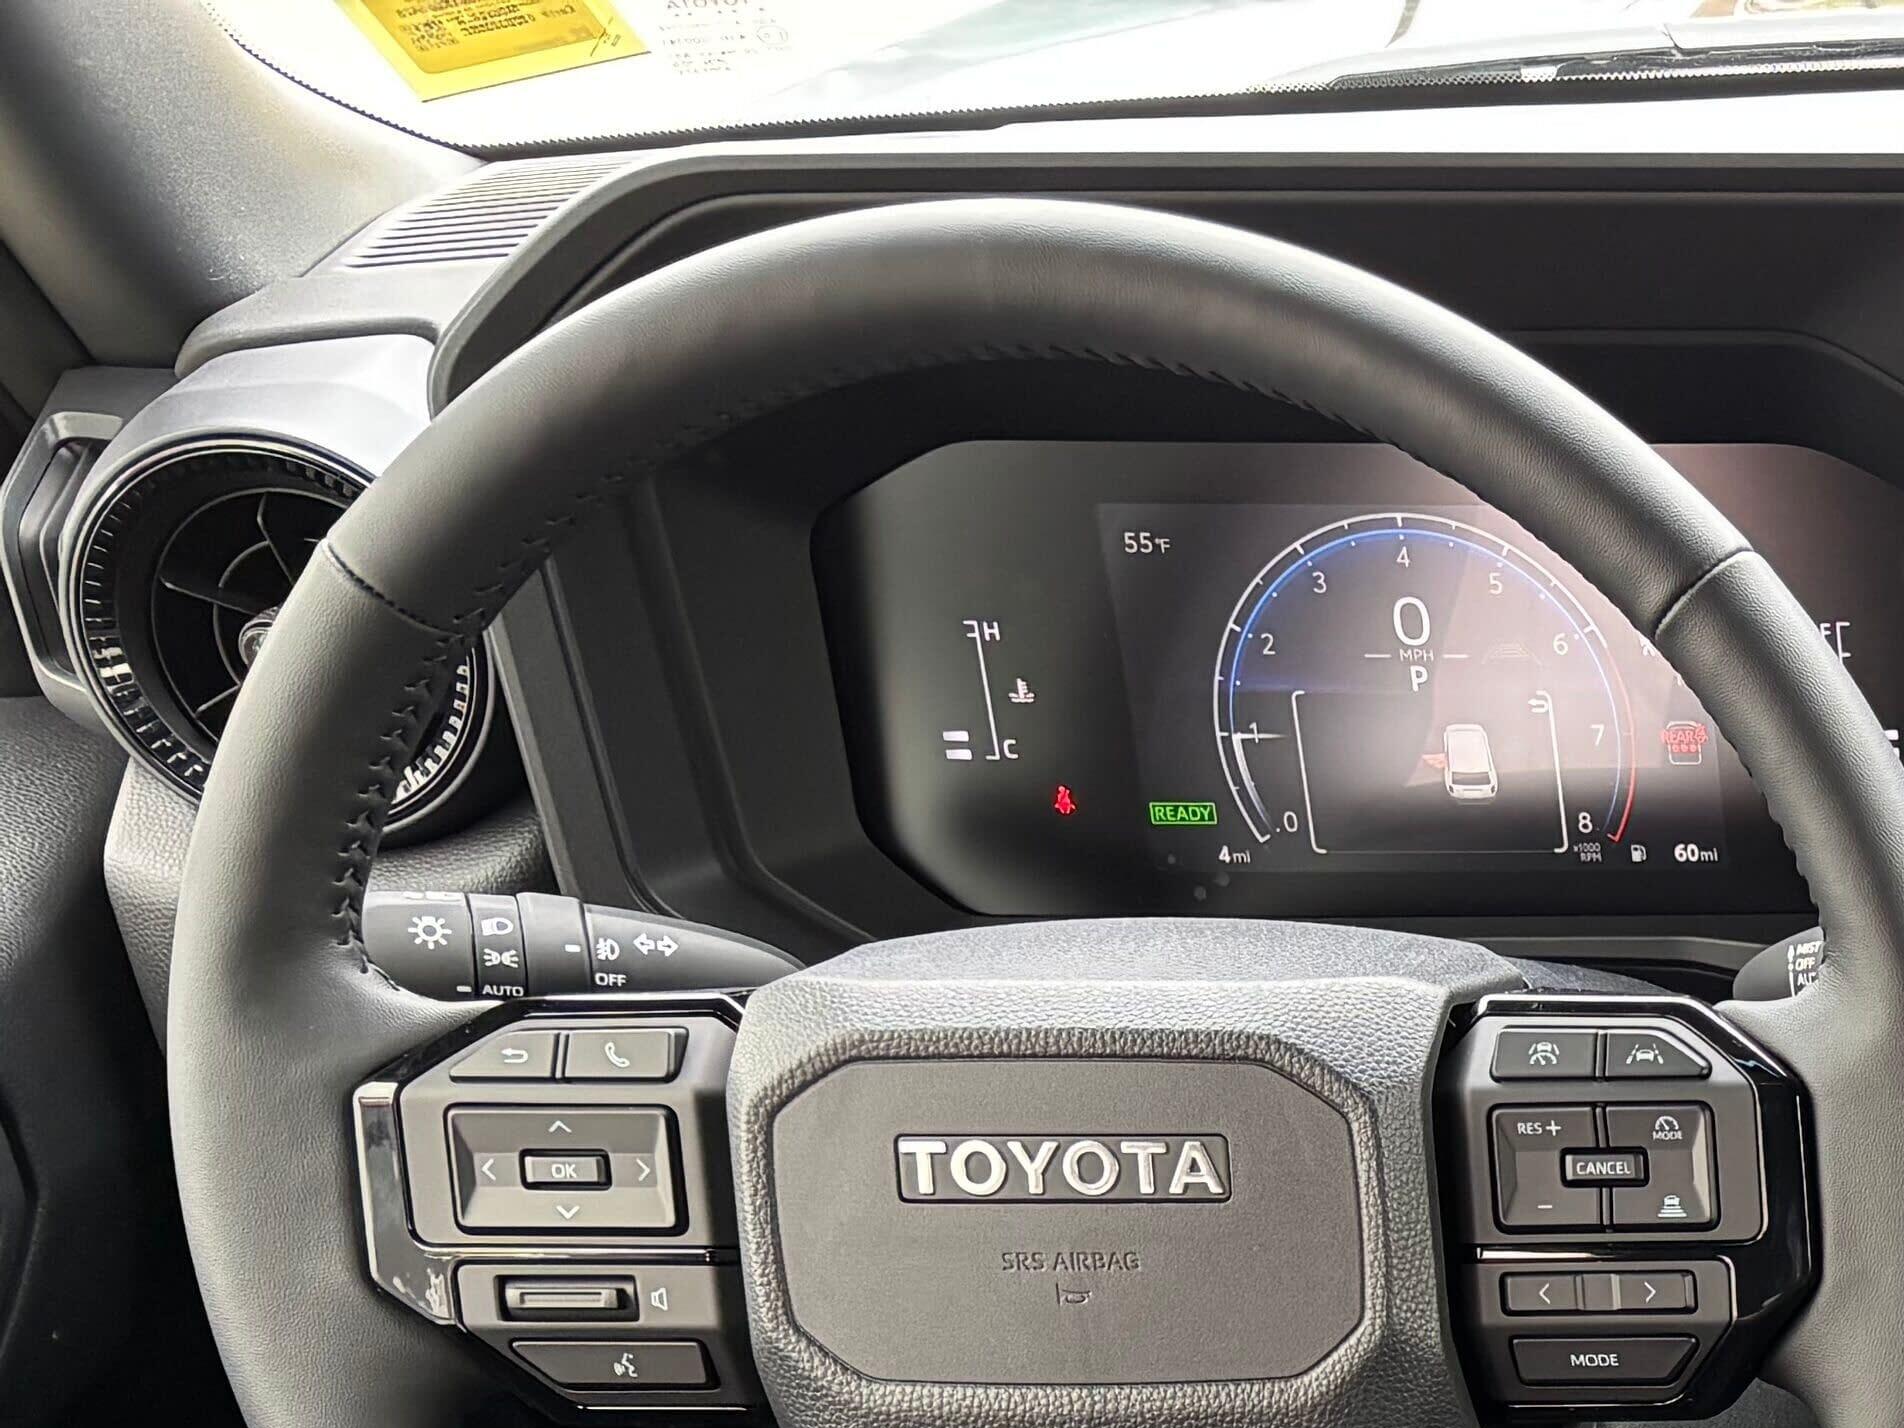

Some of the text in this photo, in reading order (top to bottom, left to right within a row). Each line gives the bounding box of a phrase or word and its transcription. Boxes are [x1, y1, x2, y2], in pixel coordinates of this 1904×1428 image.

[1396, 546, 1411, 567] 4
[1312, 571, 1327, 593] 3
[1489, 573, 1503, 595] 5
[984, 622, 1001, 641] H
[1393, 597, 1431, 646] 0
[1261, 634, 1276, 655] 2
[1553, 633, 1568, 655] 6
[1400, 649, 1434, 662] MPH
[1410, 665, 1429, 692] P
[1590, 725, 1604, 746] 7
[1003, 739, 1019, 759] C
[1155, 807, 1212, 823] READY
[1577, 812, 1592, 833] 8
[1580, 852, 1602, 863] RPM
[594, 973, 627, 987] OFF
[482, 984, 524, 998] AUTO
[1652, 1129, 1683, 1141] MODE
[551, 1162, 578, 1179] OK
[899, 1138, 1225, 1197] TOYOTA
[1575, 1160, 1631, 1176] CANCEL
[1001, 1250, 1140, 1272] SRS AIRBAG
[1569, 1353, 1619, 1368] MODE
